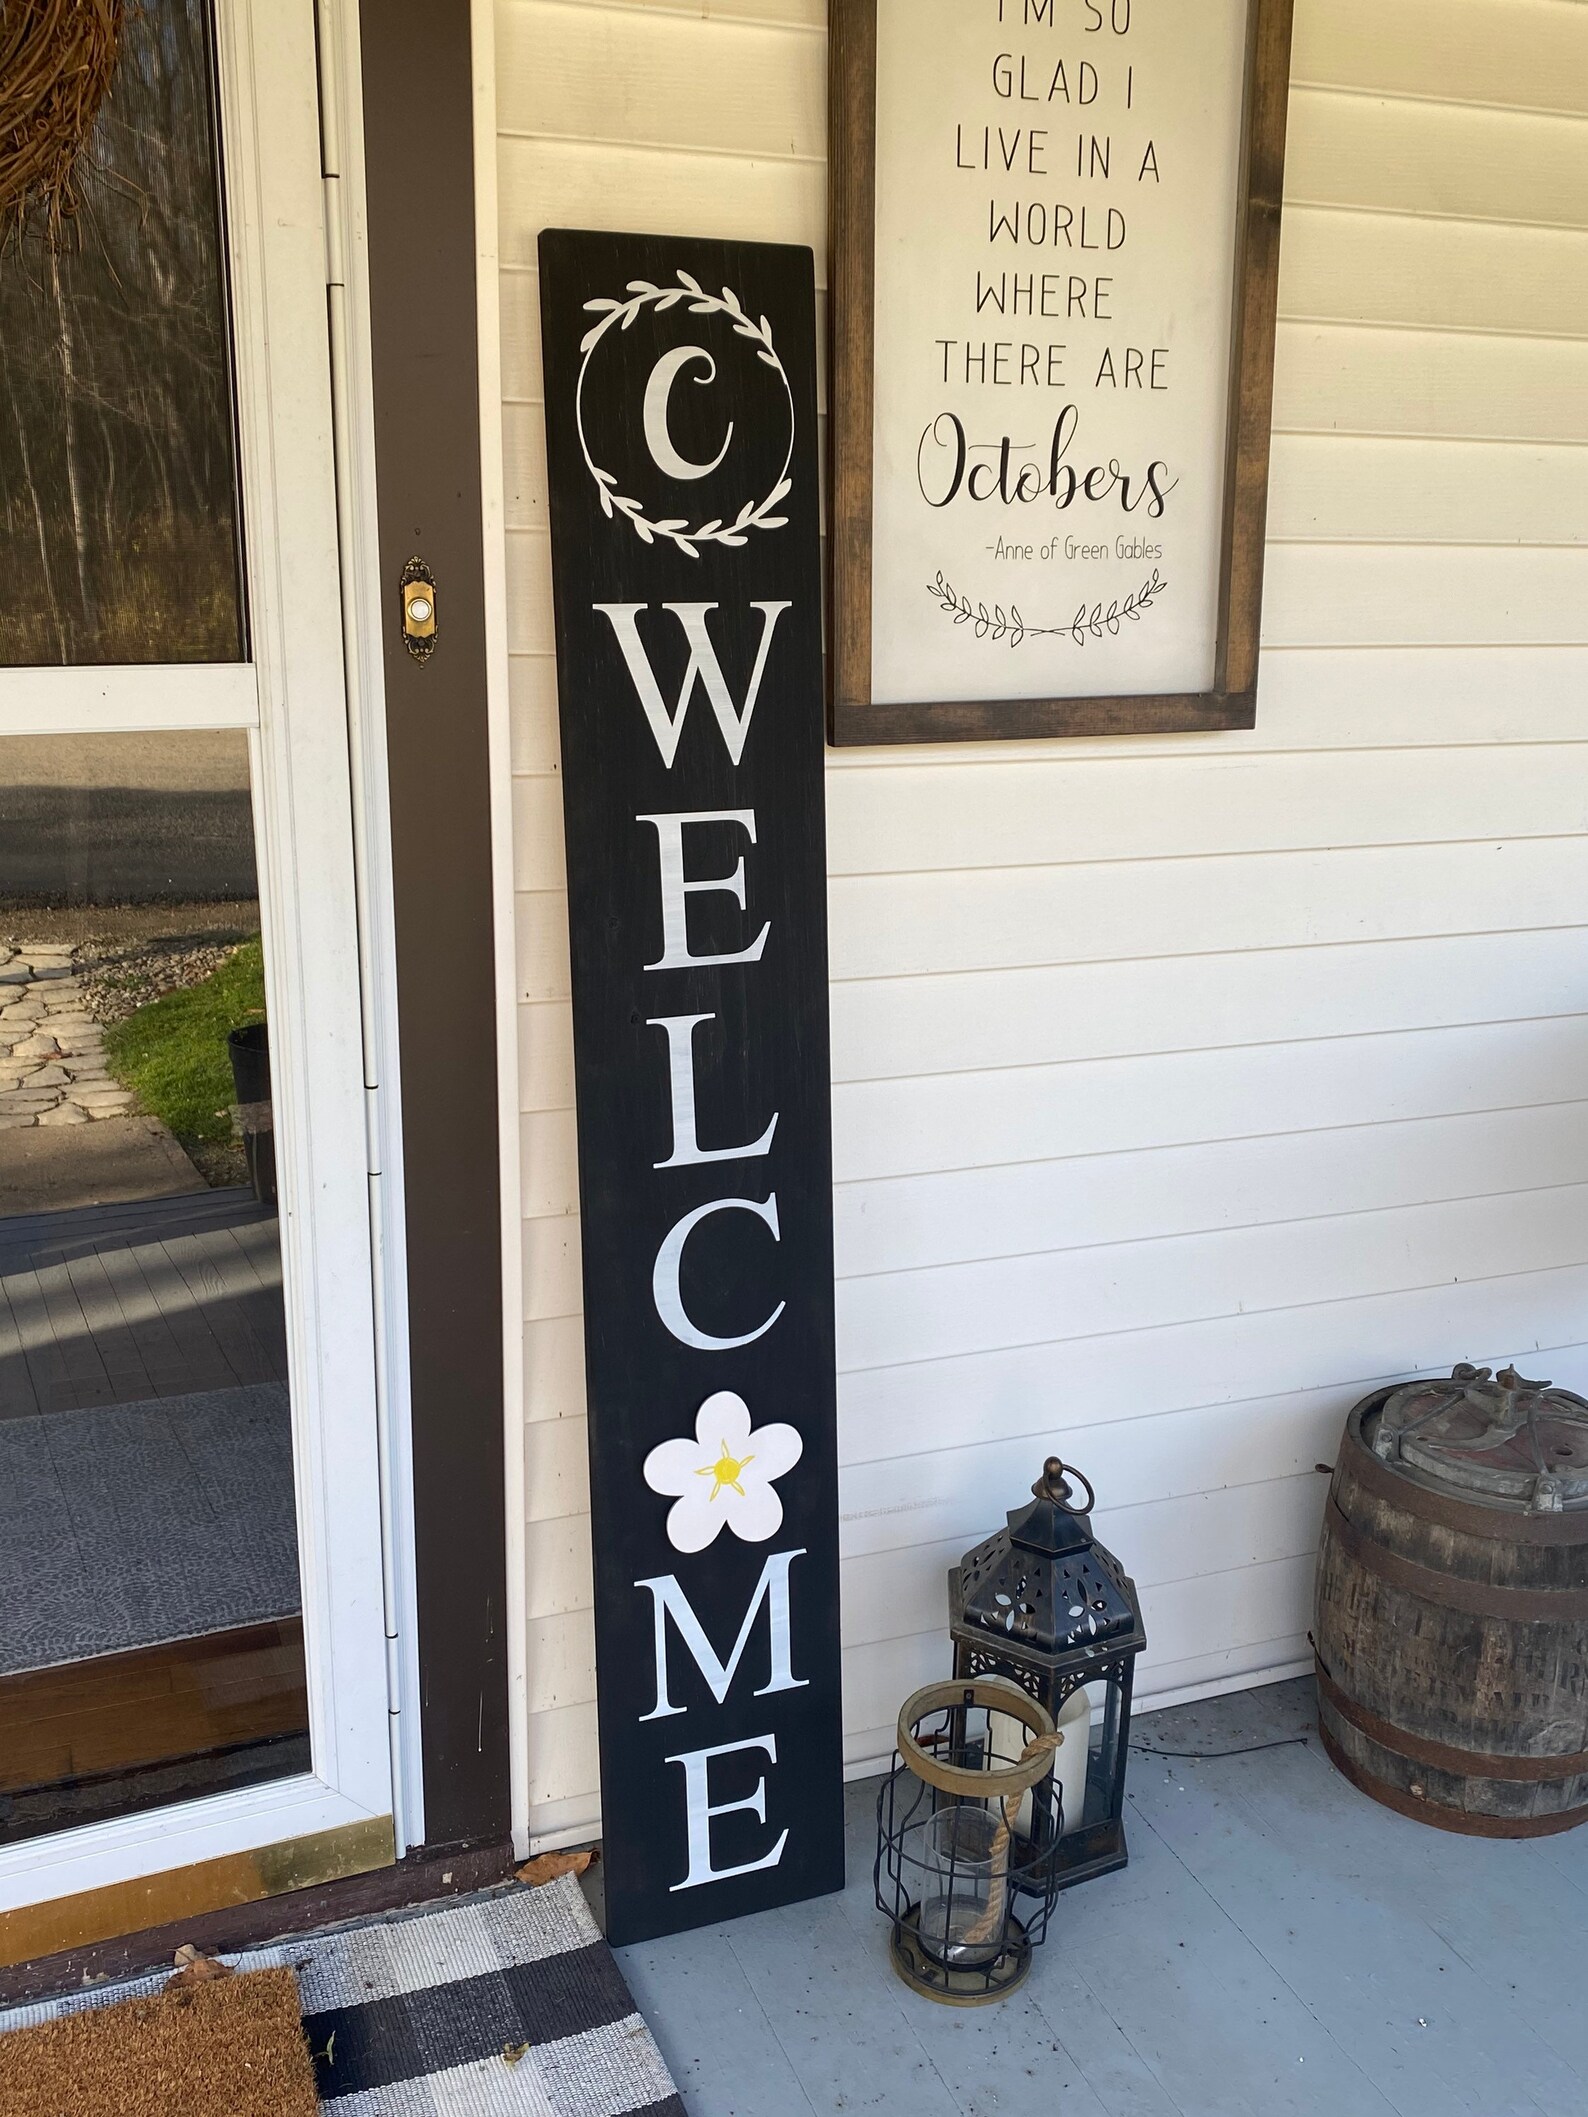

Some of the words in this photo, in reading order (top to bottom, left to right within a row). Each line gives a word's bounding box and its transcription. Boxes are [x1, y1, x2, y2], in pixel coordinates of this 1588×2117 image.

[999, 0, 1053, 27] IM
[1085, 0, 1130, 35] SO
[993, 54, 1098, 105] GLAD
[957, 124, 1048, 174] LIVE
[1078, 134, 1110, 179] IN
[1138, 140, 1159, 183] A
[990, 200, 1125, 250] WORLD
[977, 271, 1113, 319] WHERE
[935, 340, 1066, 386] THERE
[1095, 347, 1169, 389] ARE
[643, 345, 734, 480] C
[917, 404, 1179, 518] Octobers
[1040, 537, 1059, 559] of
[1065, 535, 1108, 559] Green
[1116, 535, 1162, 559] Gables
[592, 601, 809, 1892] WELCME
